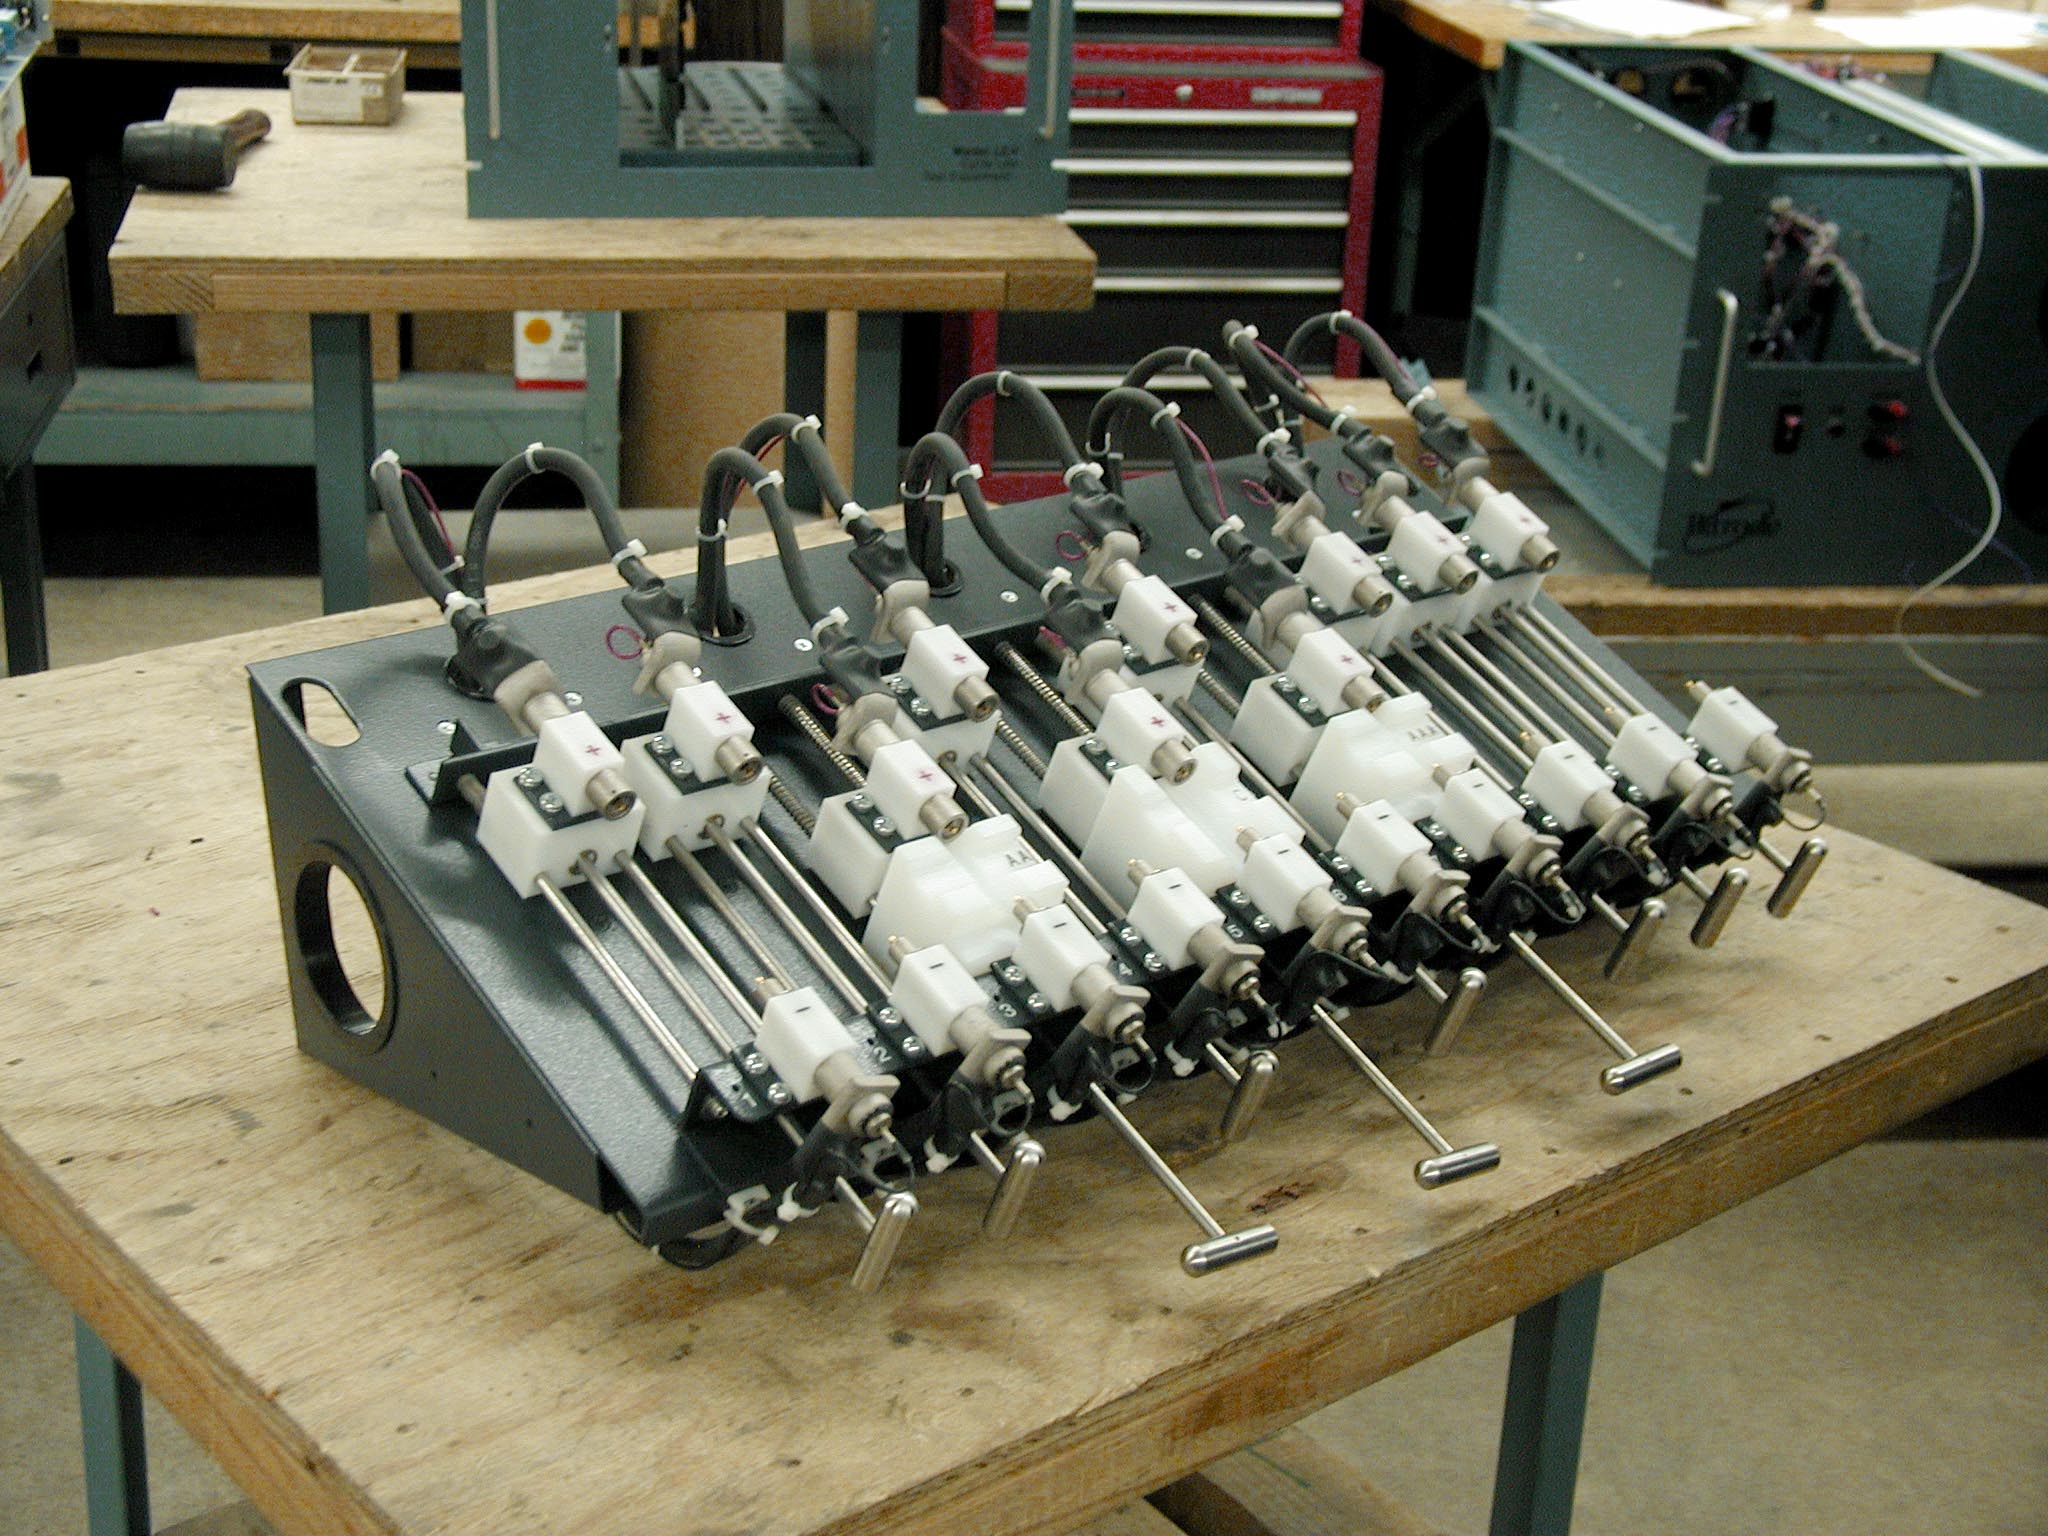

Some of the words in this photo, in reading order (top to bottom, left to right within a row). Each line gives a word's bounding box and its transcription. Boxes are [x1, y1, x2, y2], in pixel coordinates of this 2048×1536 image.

[1226, 924, 1244, 939] 5
[1119, 962, 1133, 976] 4
[998, 1003, 1017, 1018] 3
[873, 1046, 892, 1062] 2
[742, 1092, 758, 1108] 1
